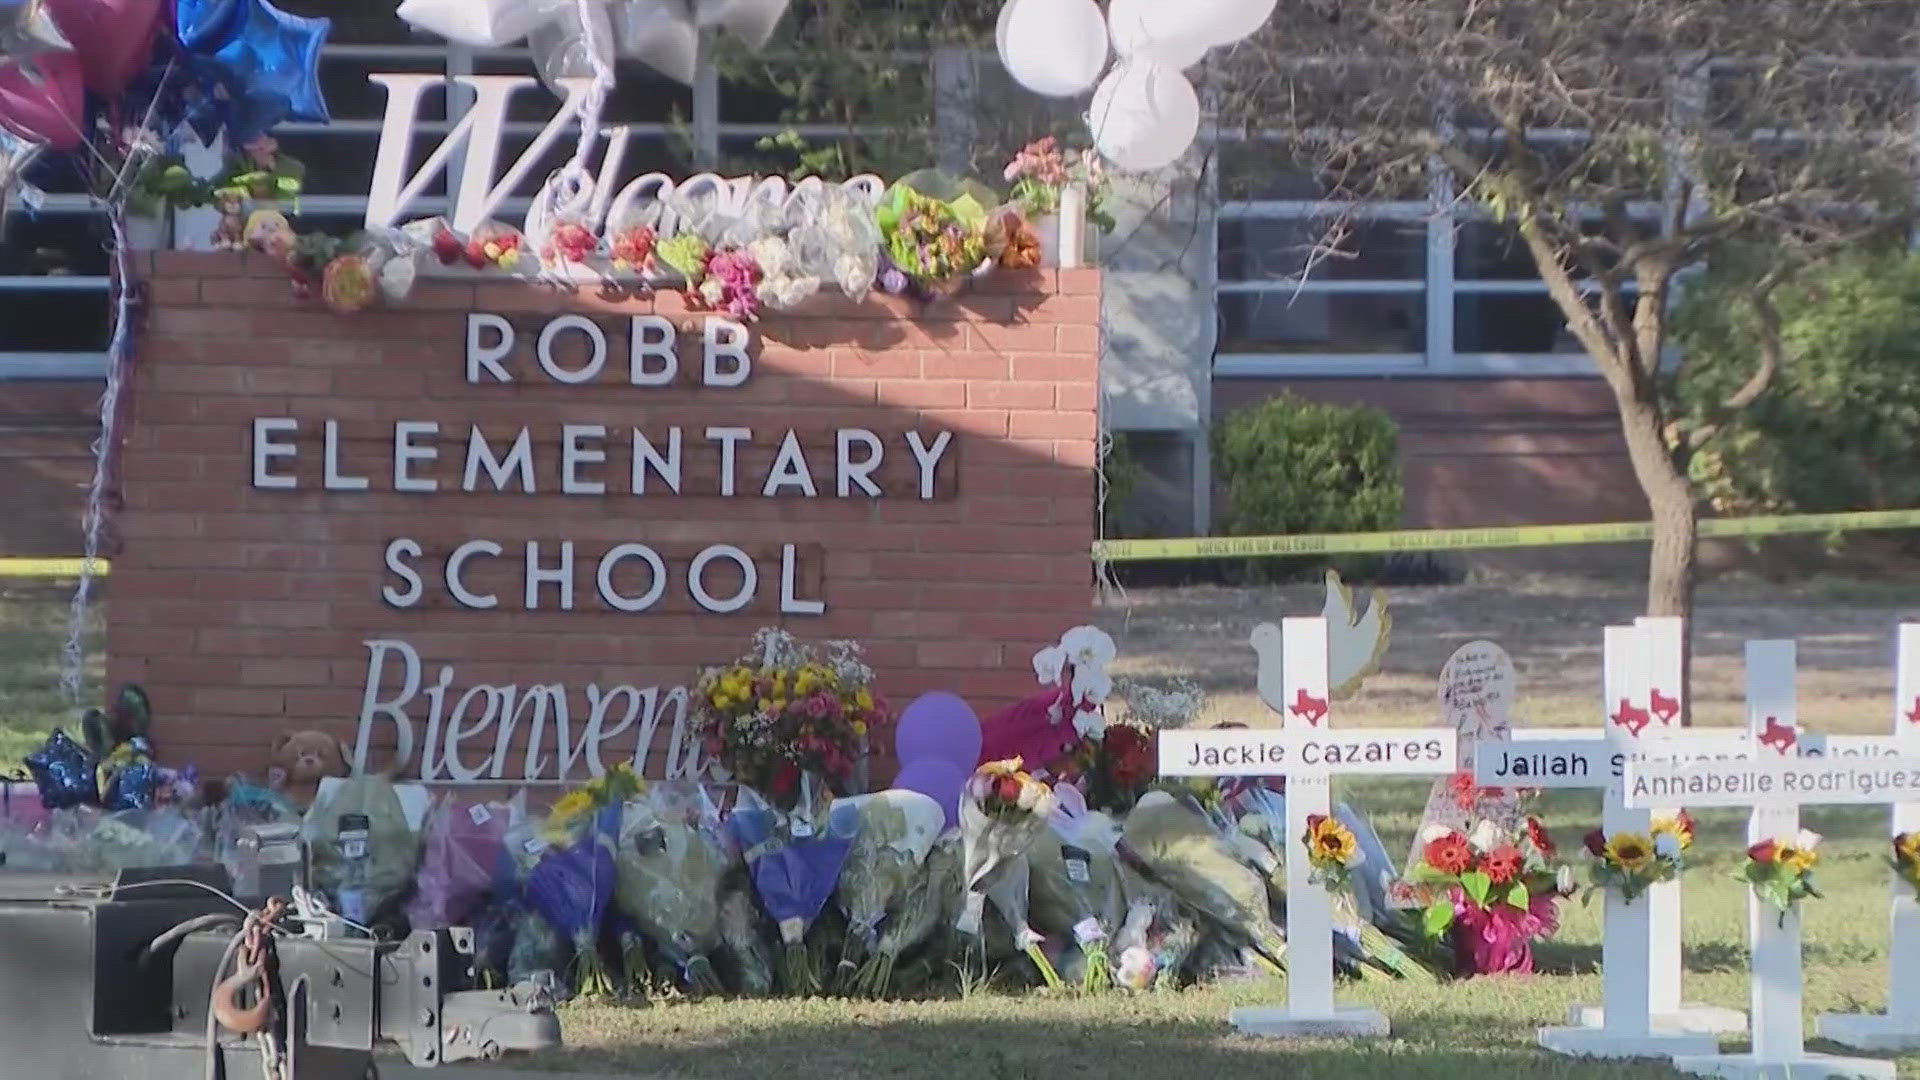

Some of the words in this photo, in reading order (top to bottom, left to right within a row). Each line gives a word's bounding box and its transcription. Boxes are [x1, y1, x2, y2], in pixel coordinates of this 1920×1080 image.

[465, 312, 752, 387] ROBB
[251, 417, 953, 499] ELEMENTARY
[381, 538, 826, 615] SCHOOL
[354, 639, 735, 783] Bienven
[1187, 741, 1285, 767] Jackie
[1301, 738, 1442, 765] Cazares
[1495, 751, 1588, 777] Jailah
[1632, 772, 1773, 797] Annabelle
[1783, 768, 1920, 795] Rodriguez
